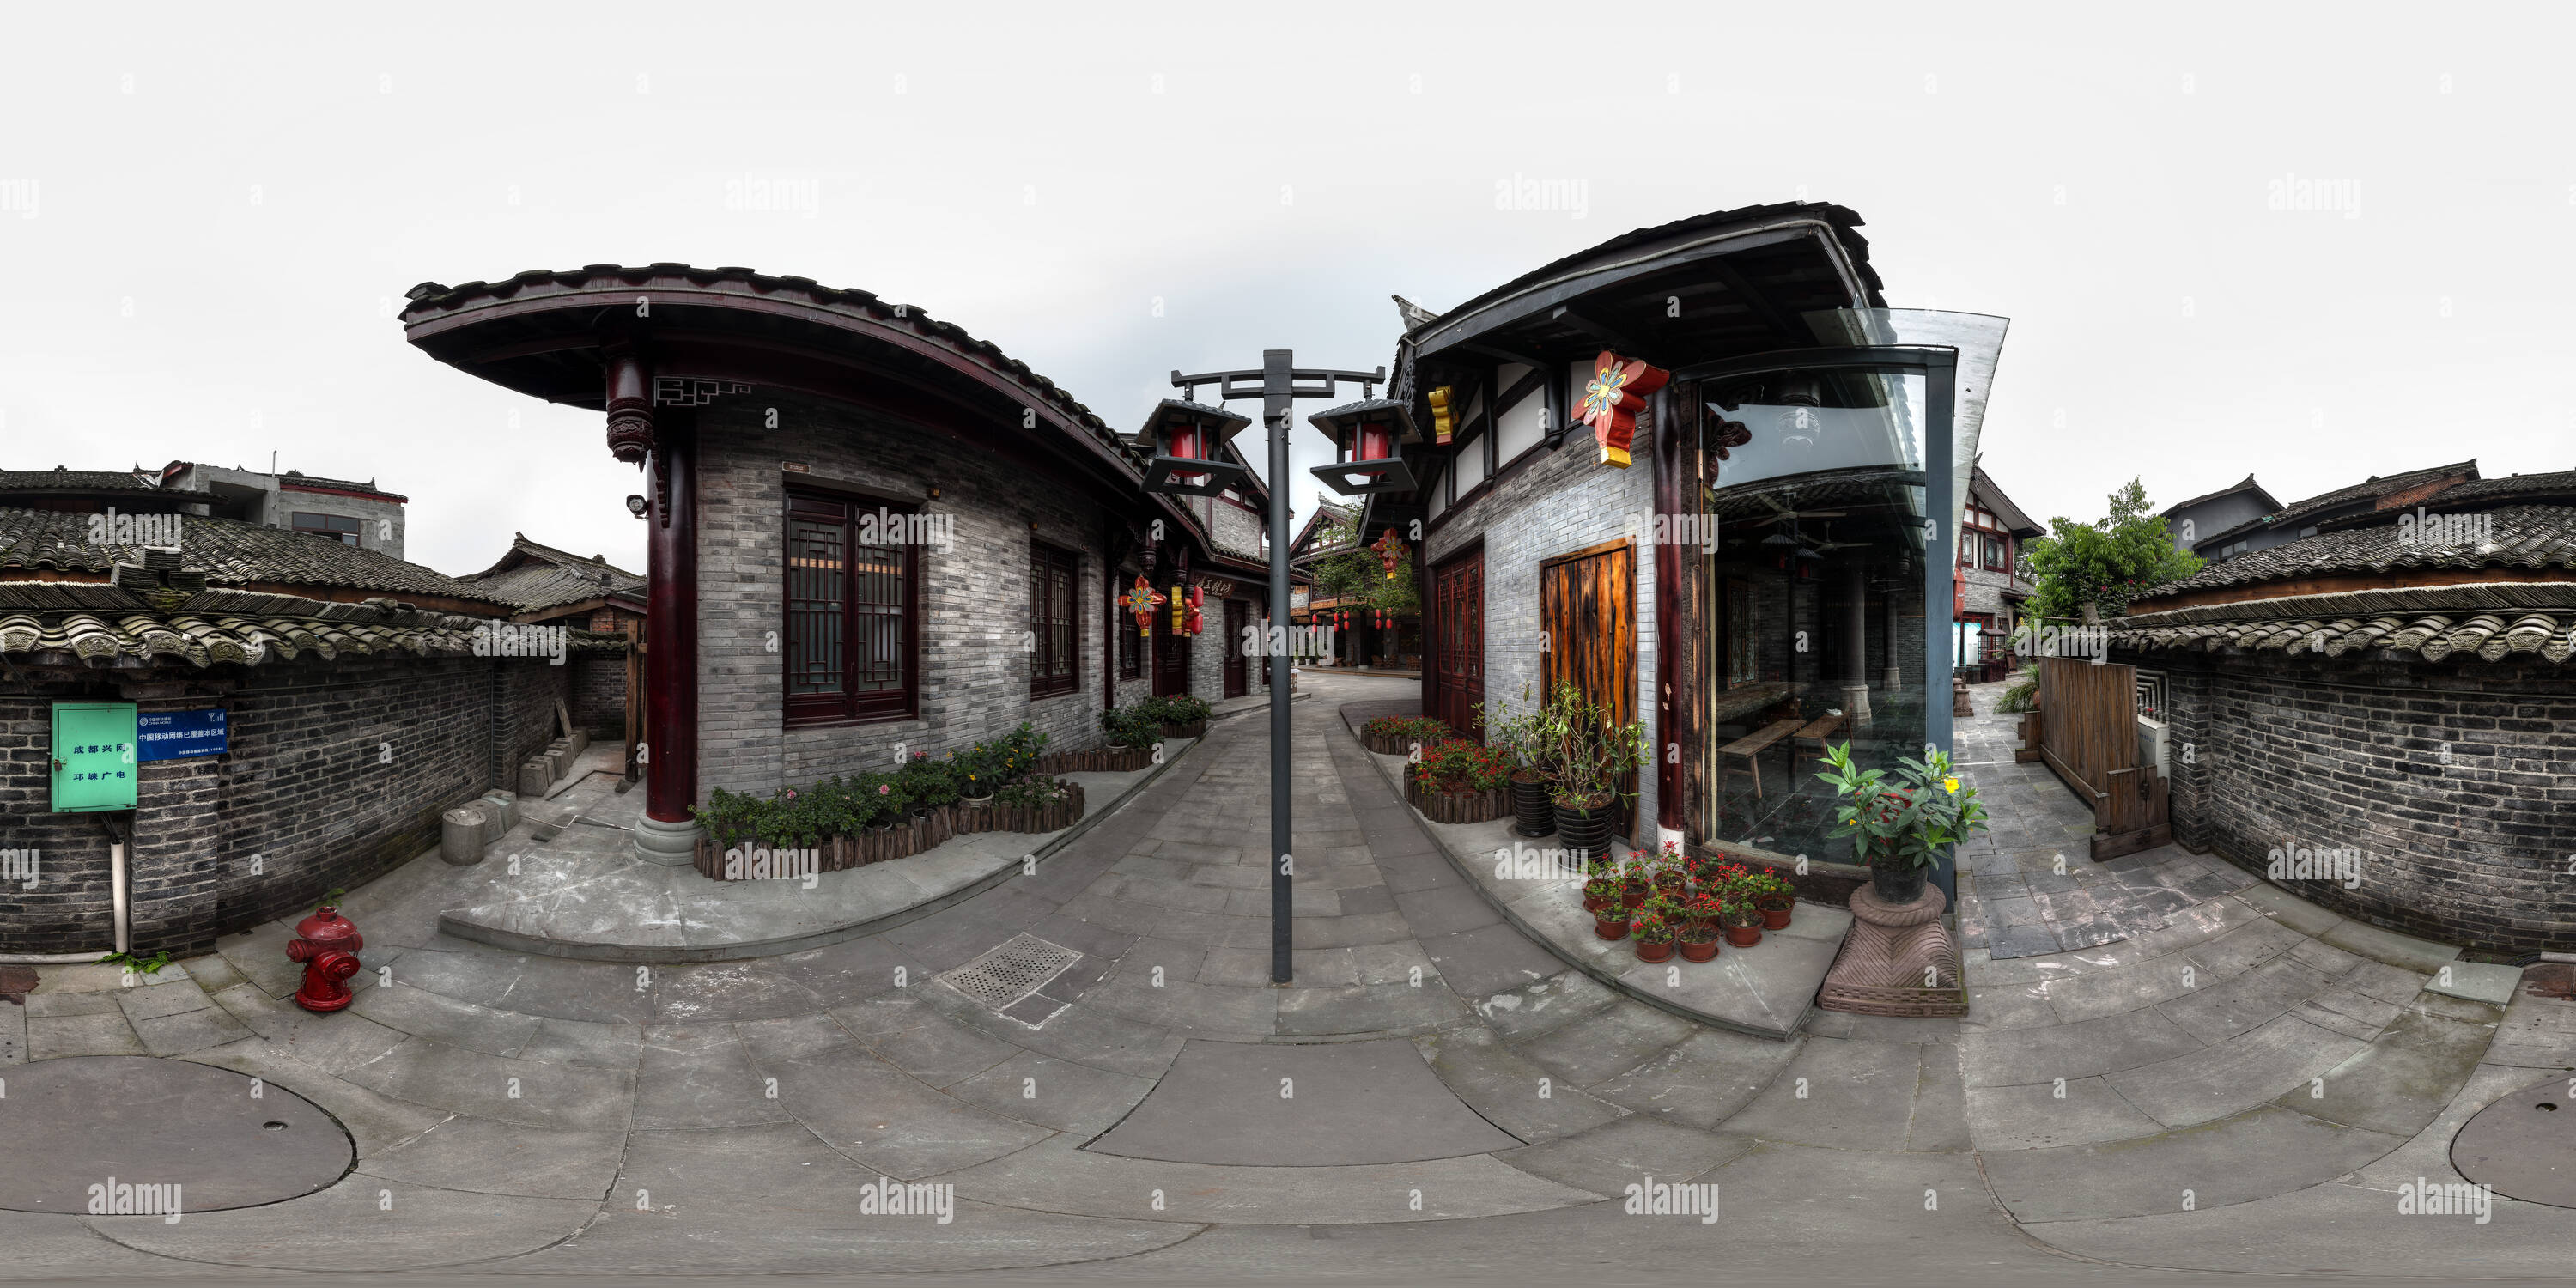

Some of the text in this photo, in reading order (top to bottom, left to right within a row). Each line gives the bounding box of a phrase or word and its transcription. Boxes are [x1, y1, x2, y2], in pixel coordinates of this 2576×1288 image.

[138, 728, 224, 742] 中国移动网络已覆盖本区域
